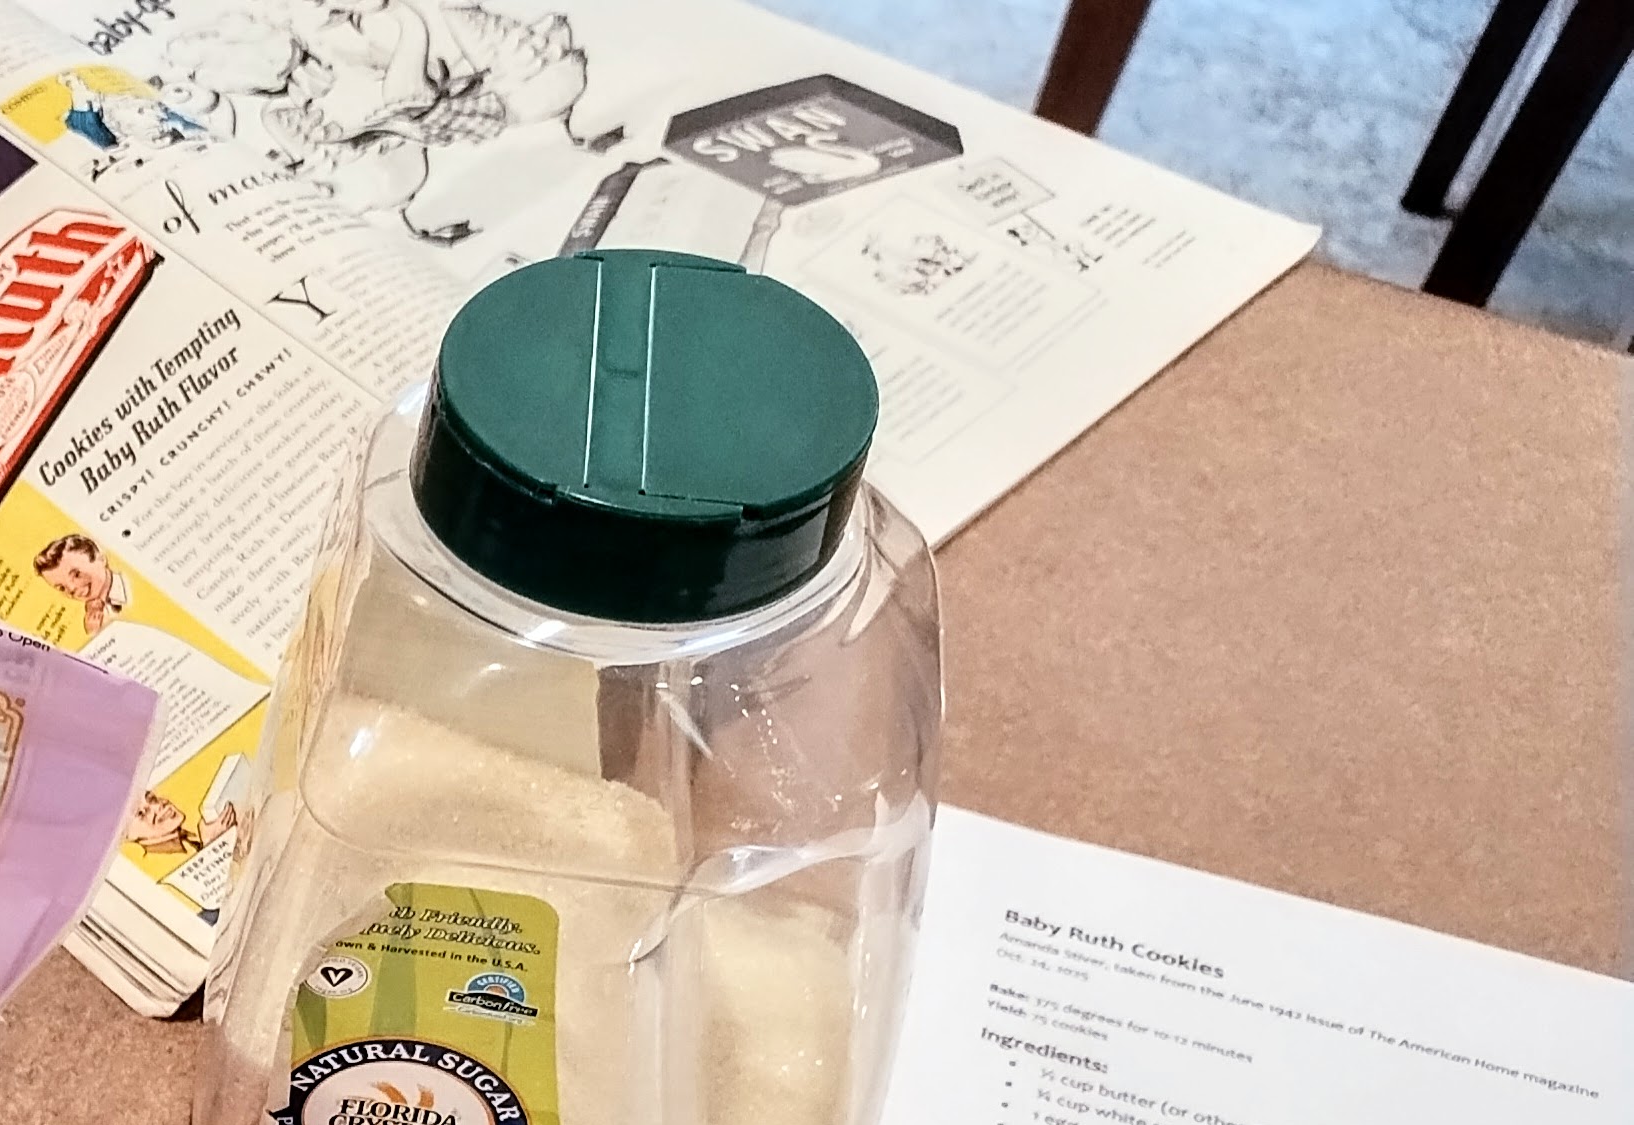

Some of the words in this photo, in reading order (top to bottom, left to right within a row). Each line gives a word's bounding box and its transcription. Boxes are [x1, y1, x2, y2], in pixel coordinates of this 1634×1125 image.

[692, 103, 848, 163] SWAN
[39, 417, 113, 487] Cookies
[115, 375, 158, 421] with
[150, 307, 241, 383] Tempting
[80, 442, 136, 495] Baby
[132, 396, 182, 448] Ruth
[178, 347, 239, 404] Flavor
[99, 468, 156, 523] CRISPY!
[159, 400, 232, 467] CRUNCHY!
[235, 347, 293, 399] CHEWY!
[367, 942, 377, 951] &
[381, 944, 447, 960] Harvested
[450, 951, 462, 962] in
[466, 953, 488, 965] the
[491, 957, 528, 973] U.S.A.
[1005, 909, 1061, 936] Baby
[1069, 926, 1123, 951] Ruth
[1131, 943, 1223, 977] Cookies
[292, 1043, 430, 1092] NATURAL
[438, 1053, 521, 1122] SUGAR
[981, 1027, 1107, 1073] Ingredients:
